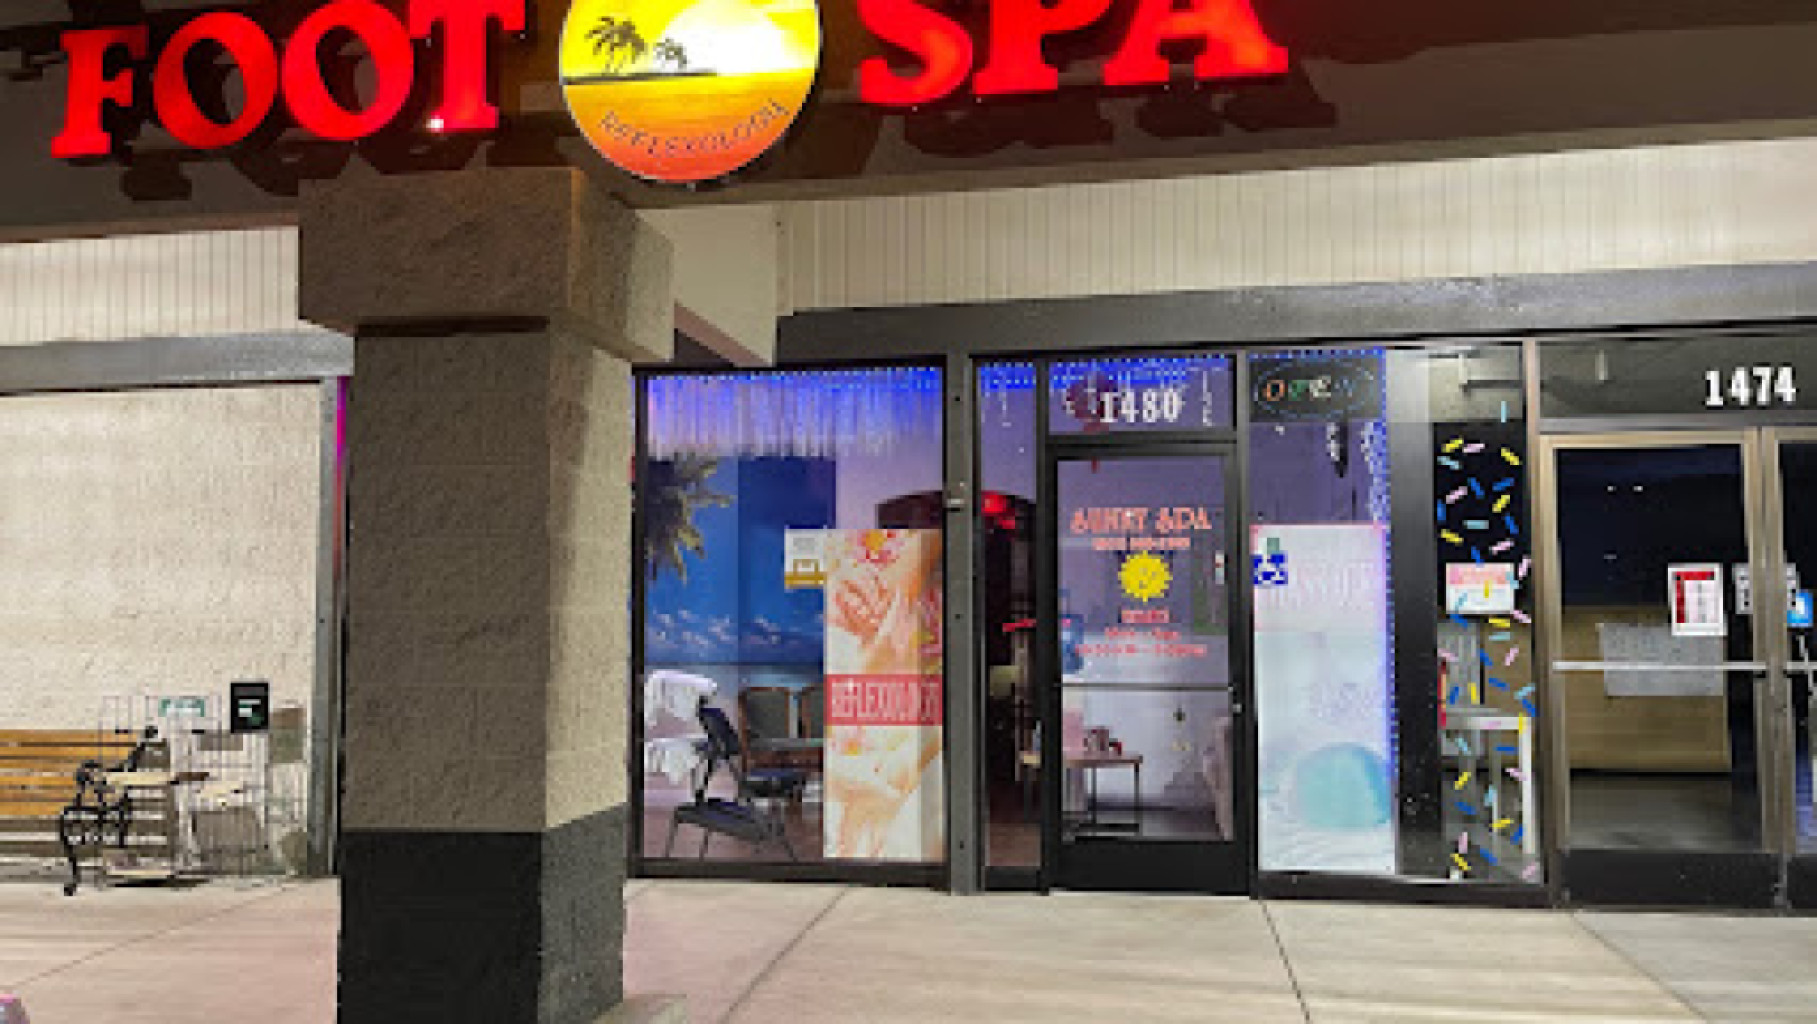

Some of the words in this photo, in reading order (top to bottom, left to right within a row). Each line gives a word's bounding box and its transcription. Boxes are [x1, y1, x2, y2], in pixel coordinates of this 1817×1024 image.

[51, 0, 526, 158] FOOT
[860, 0, 1289, 106] SPA
[1100, 388, 1181, 423] 1480
[1704, 366, 1797, 406] 1474
